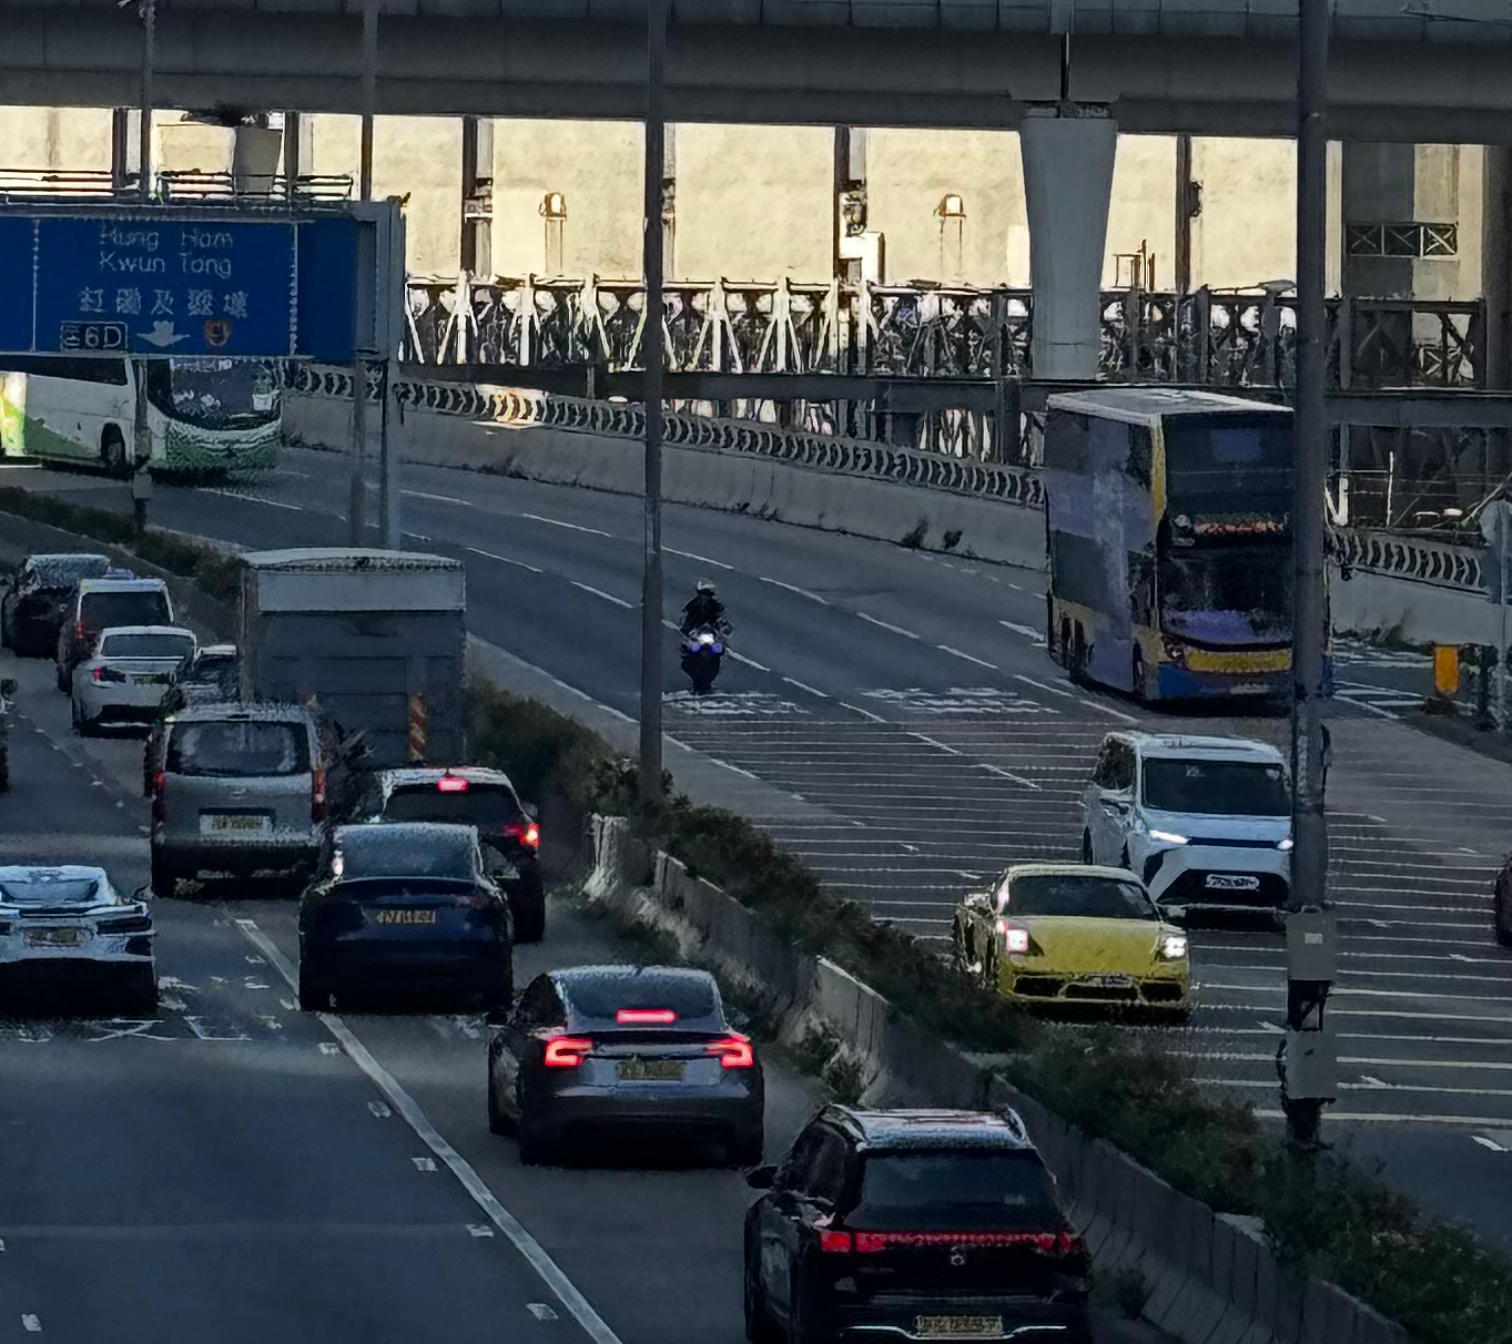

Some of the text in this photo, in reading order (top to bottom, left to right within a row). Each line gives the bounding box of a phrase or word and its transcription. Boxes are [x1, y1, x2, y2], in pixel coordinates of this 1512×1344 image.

[99, 226, 160, 252] Hung
[98, 250, 232, 279] Kwun Tong
